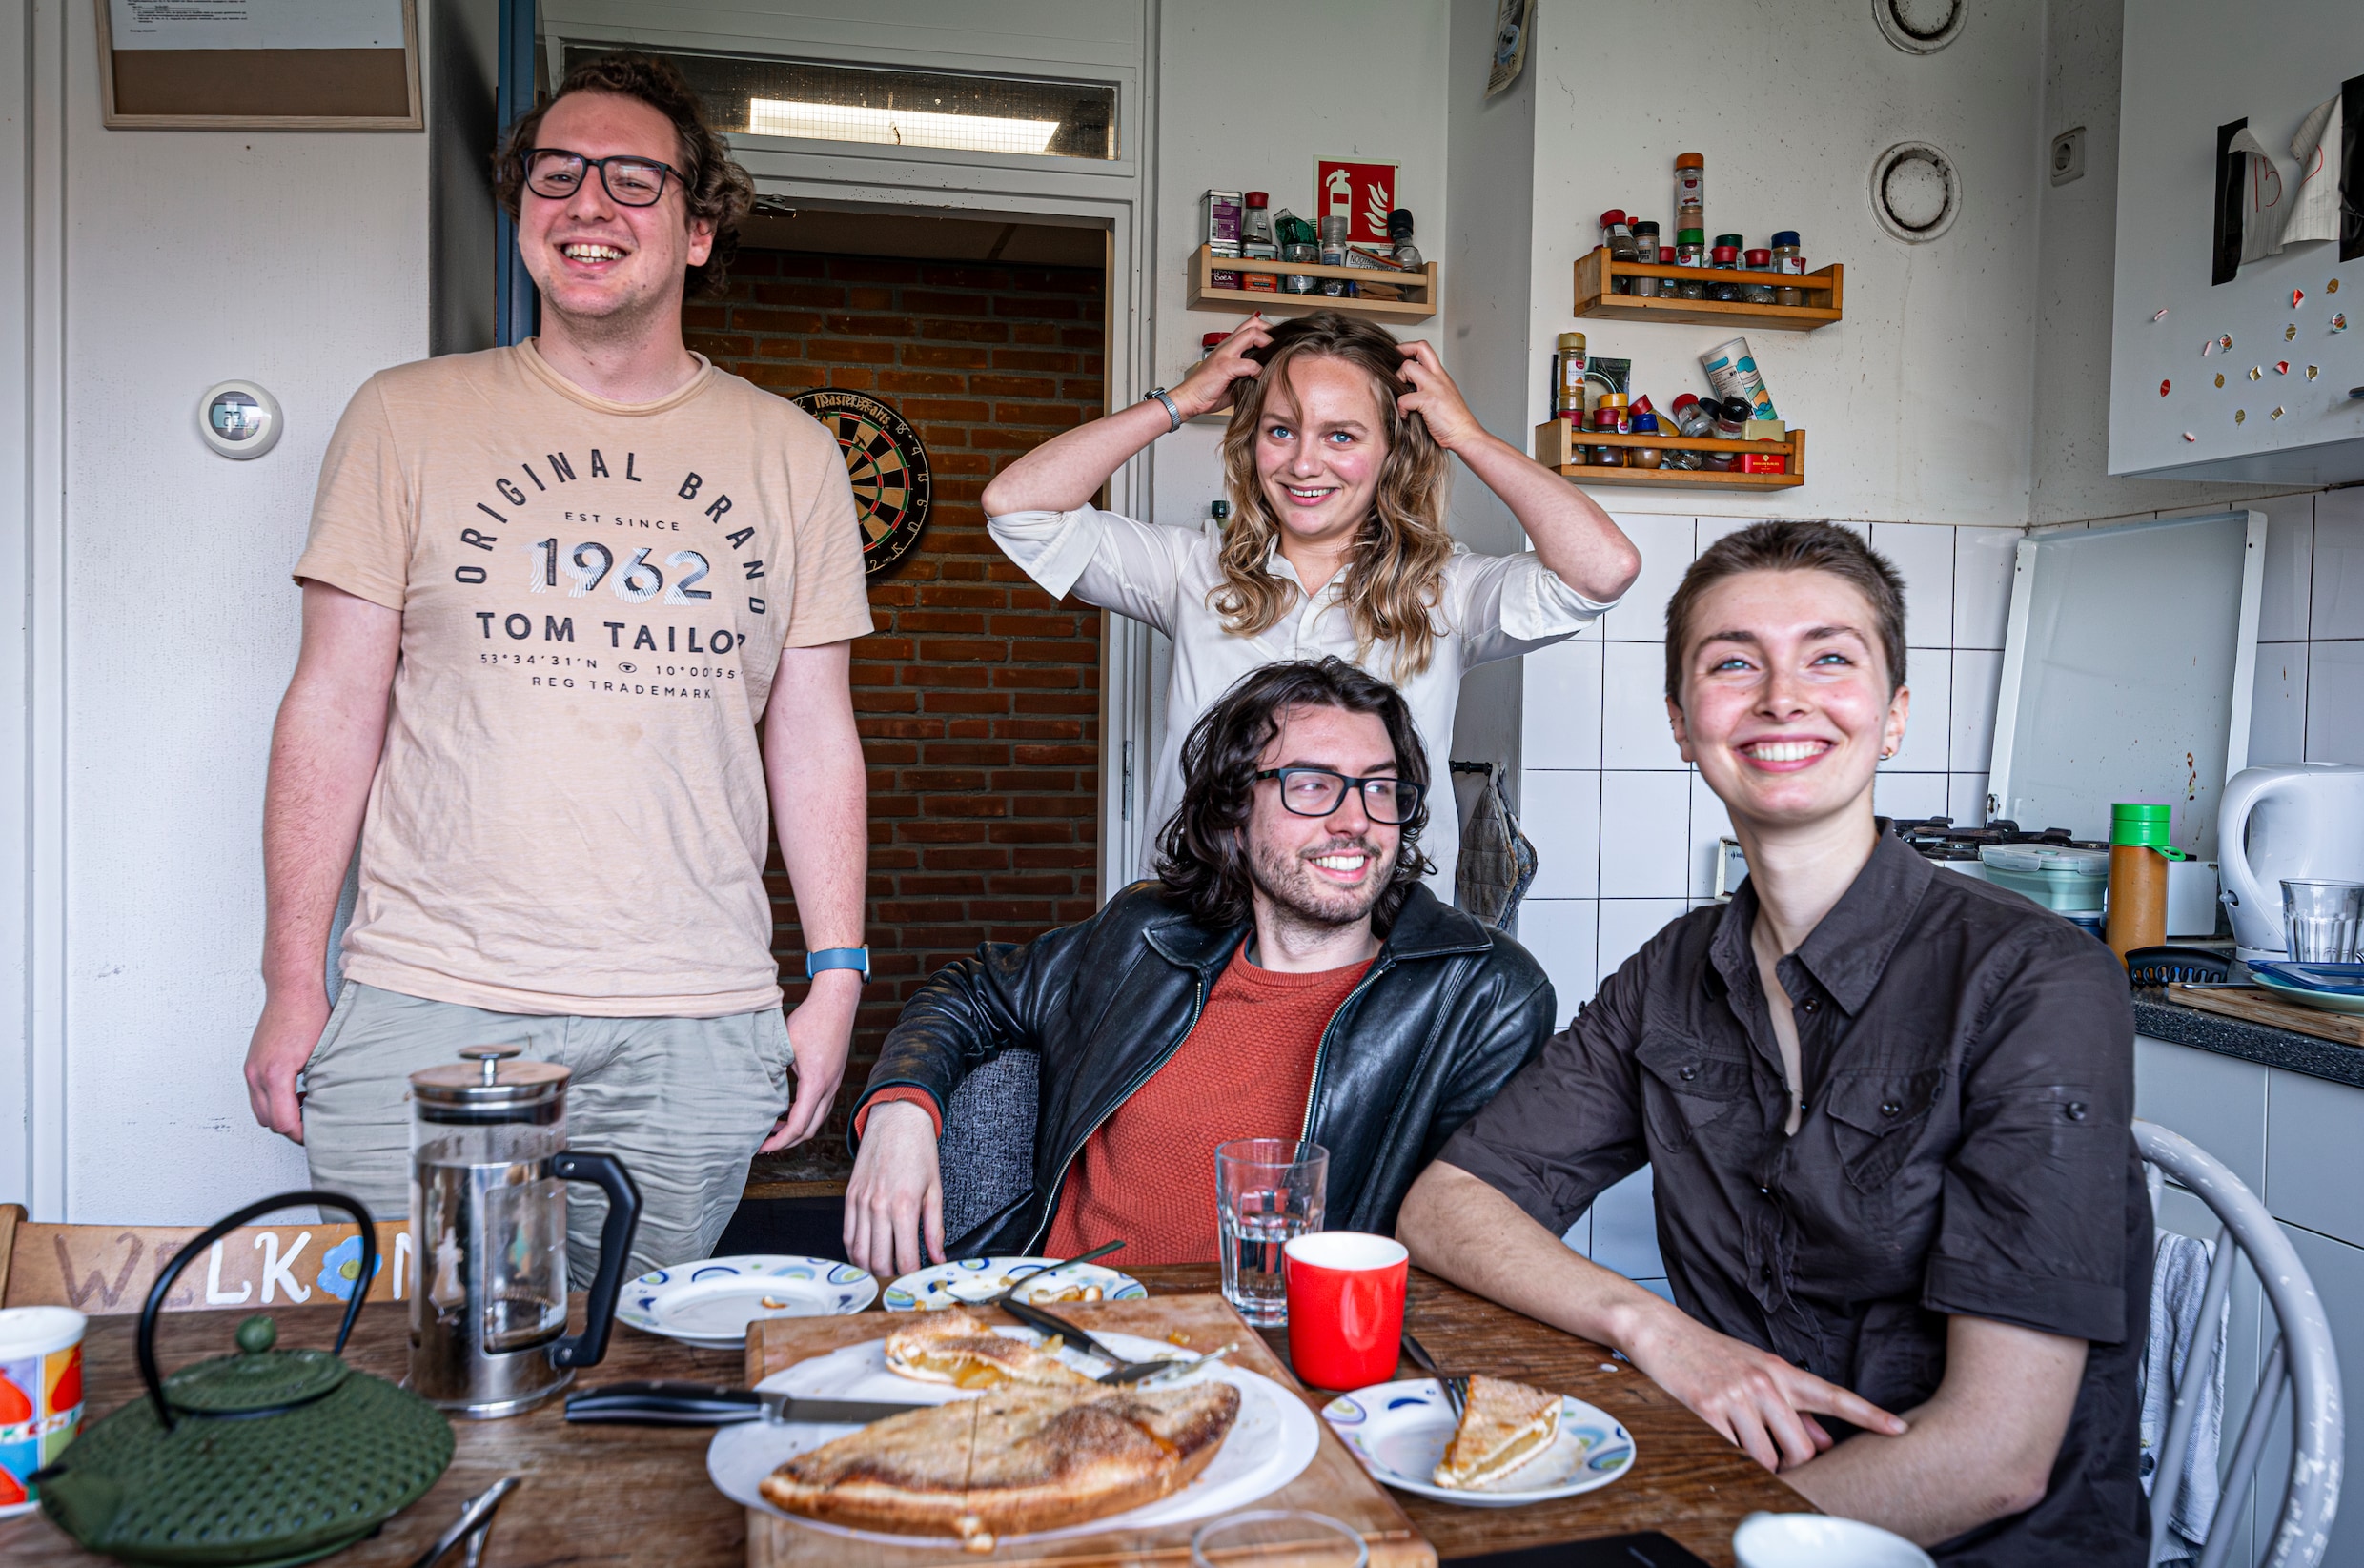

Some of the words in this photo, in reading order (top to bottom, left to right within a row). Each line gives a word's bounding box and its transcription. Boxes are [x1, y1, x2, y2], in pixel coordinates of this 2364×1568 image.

[911, 445, 921, 456] 4
[917, 471, 928, 482] 13
[455, 449, 642, 584] ORIGINAL
[678, 472, 765, 615] BRAND
[565, 511, 601, 523] EST
[615, 517, 680, 531] SINCE
[525, 538, 712, 606] 1962
[477, 612, 575, 642] TOM
[532, 677, 575, 688] REG
[589, 680, 711, 699] TRADEMARK
